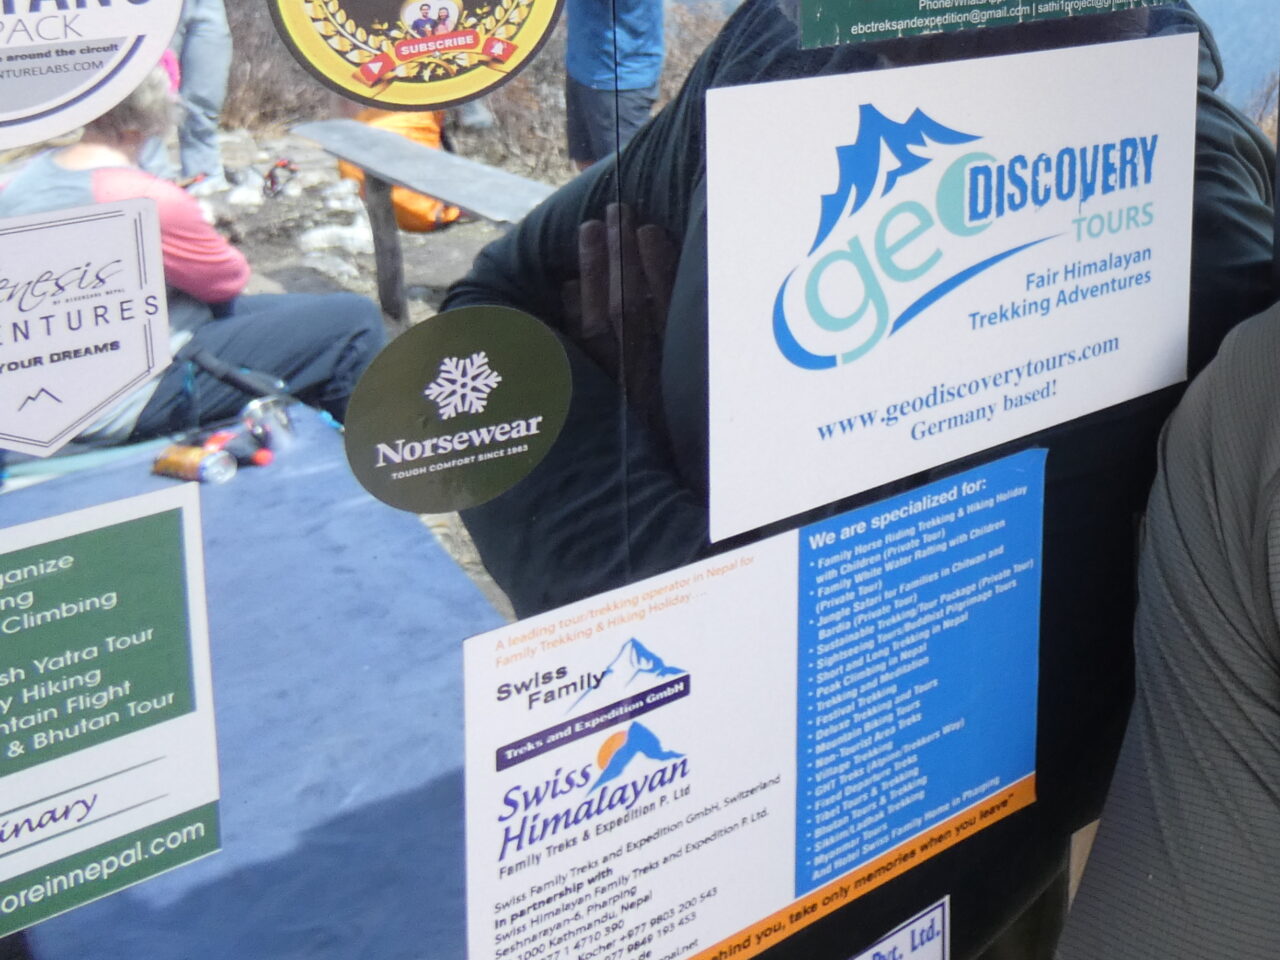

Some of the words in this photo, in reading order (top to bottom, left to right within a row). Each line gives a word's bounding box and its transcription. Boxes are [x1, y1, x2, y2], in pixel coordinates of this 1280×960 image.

[400, 35, 475, 55] SUBSCRIBE
[851, 5, 1030, 35] ebctreksandexpedition@gmail.com
[6, 50, 55, 62] around
[55, 48, 76, 57] the
[80, 43, 119, 55] circuit
[968, 134, 1158, 221] DISCOVERY
[1072, 202, 1154, 242] TOURS
[1026, 269, 1059, 291] Fair
[1064, 247, 1151, 282] Himalayan
[968, 294, 1051, 330] Trekking
[1056, 270, 1151, 307] Adventures
[50, 340, 120, 363] DREAMS
[817, 335, 1120, 442] www.geodiscoverytours.com
[911, 405, 996, 442] Germany
[1003, 379, 1057, 411] based!
[375, 416, 543, 468] Norsewear
[392, 466, 427, 480] TOUGH
[429, 456, 476, 472] COMFORT
[478, 449, 504, 461] SINCE
[808, 531, 836, 550] We
[840, 521, 867, 540] are
[870, 485, 958, 530] specialized
[961, 479, 987, 497] for:
[817, 550, 852, 569] Family
[918, 512, 956, 531] Trekking
[966, 498, 994, 514] Hiking
[996, 486, 1028, 503] Holiday
[0, 554, 74, 590] anize
[2, 591, 118, 634] Climbing
[496, 640, 505, 651] A
[508, 624, 556, 647] leading
[641, 578, 690, 601] operator
[693, 573, 704, 583] in
[706, 560, 738, 578] Nepal
[740, 556, 754, 567] for
[33, 646, 98, 673] Yatra
[105, 628, 154, 652] Tour
[496, 646, 537, 668] Family
[540, 627, 593, 651] Trekking
[596, 622, 605, 632] &
[607, 609, 645, 628] Hiking
[23, 669, 101, 704] Hiking
[66, 680, 131, 715] Flight
[496, 666, 568, 702] Swiss
[528, 670, 607, 710] Family
[7, 740, 25, 758] &
[33, 711, 119, 749] Bhutan
[127, 692, 175, 717] Tour
[504, 738, 544, 760] Treks
[546, 725, 573, 743] and
[574, 700, 644, 733] Expedition
[646, 681, 685, 704] GmbH
[498, 764, 593, 822] Swiss
[498, 758, 690, 862] Himalayan
[494, 893, 527, 914] Swiss
[530, 873, 568, 897] Family
[570, 859, 599, 878] Treks
[602, 845, 623, 863] and
[626, 820, 684, 853] Expedition
[686, 802, 721, 824] GmbH,
[723, 773, 781, 808] Switzerland
[499, 852, 542, 880] Family
[546, 836, 578, 858] Treks
[582, 829, 590, 842] &
[595, 800, 656, 836] Expedition
[659, 796, 670, 808] P.
[673, 783, 691, 800] Ltd
[1, 821, 205, 914] oreinnepal.com
[495, 923, 527, 945] Swiss
[530, 893, 592, 928] Himalayan
[594, 874, 630, 897] Family
[632, 859, 660, 879] Treks
[662, 847, 683, 865] and
[685, 822, 739, 854] Expedition
[751, 807, 770, 823] Ltd.
[755, 921, 786, 945] you,
[788, 902, 818, 924] take
[822, 884, 850, 908] only
[853, 849, 917, 890] memories
[919, 829, 952, 853] when
[954, 815, 977, 837] you
[495, 918, 507, 930] In
[510, 882, 584, 925] partnership
[587, 866, 613, 885] with
[549, 912, 618, 949] Kathmandu,
[620, 889, 653, 914] Nepal
[586, 885, 638, 916] Pharping
[910, 917, 941, 952] Ltd.
